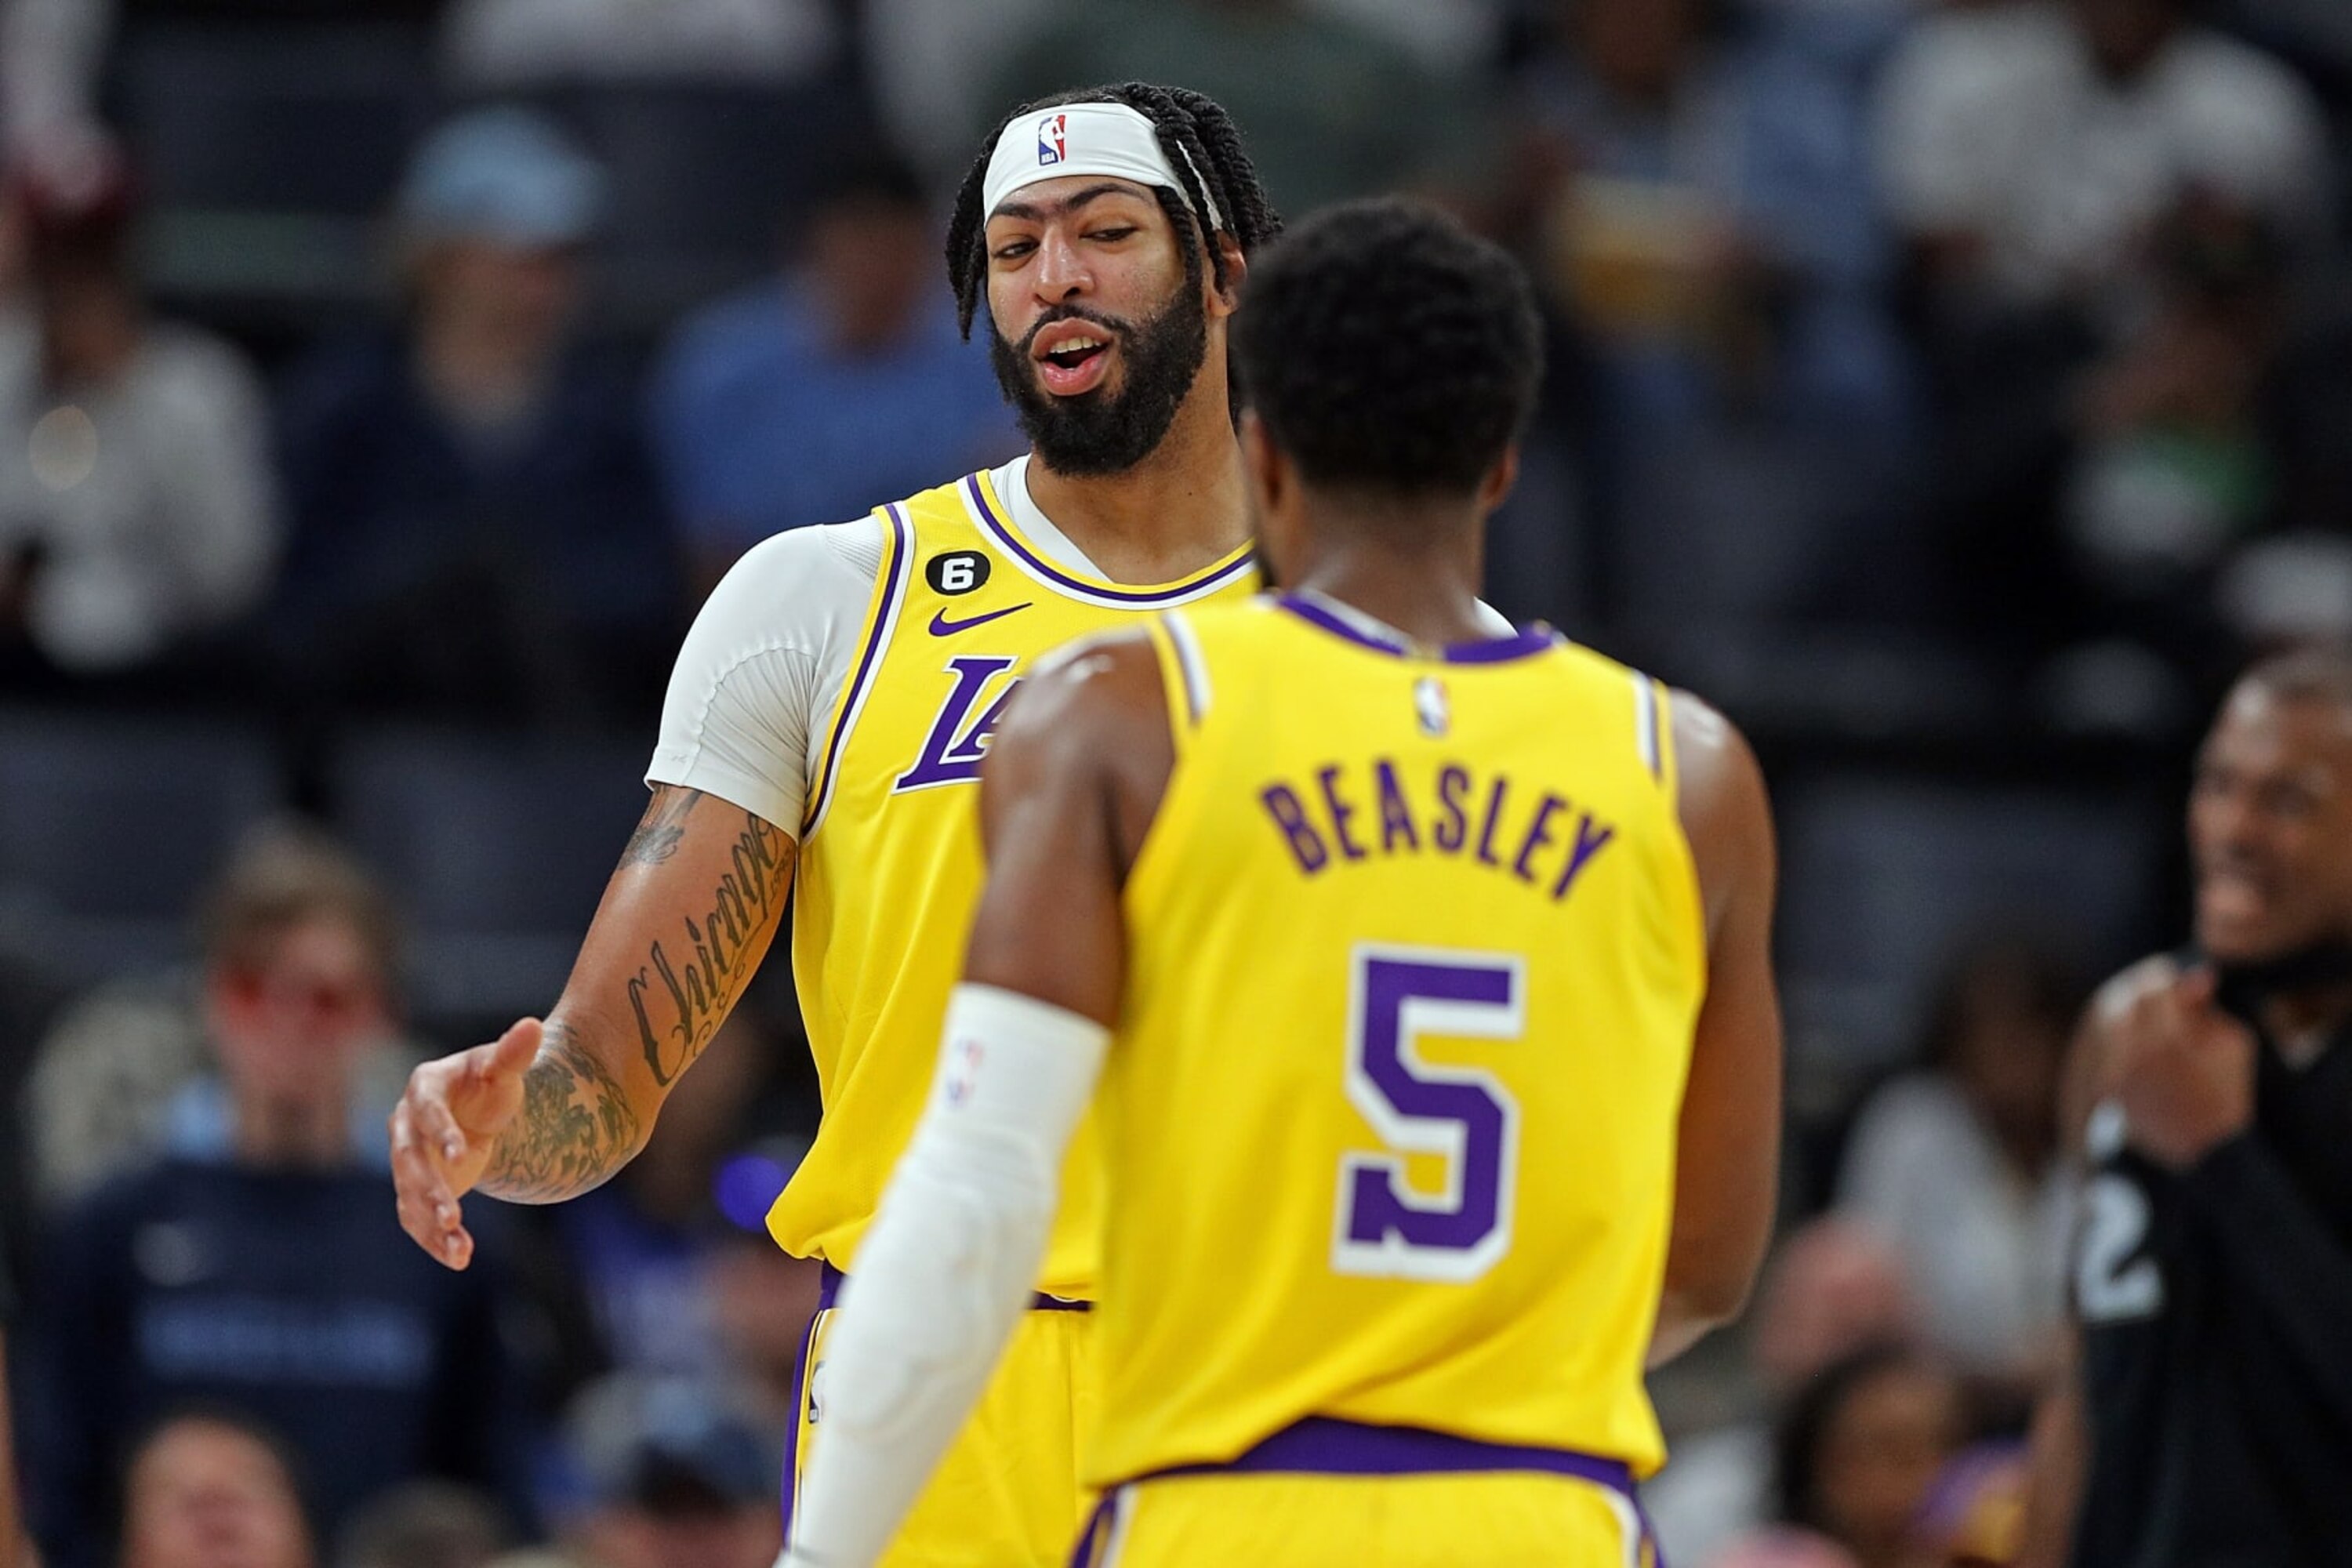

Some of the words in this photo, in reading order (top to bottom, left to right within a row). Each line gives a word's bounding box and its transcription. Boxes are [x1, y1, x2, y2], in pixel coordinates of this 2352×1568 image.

[941, 557, 975, 590] 6
[1259, 758, 1615, 902] BEASLEY
[1330, 940, 1527, 1285] 5
